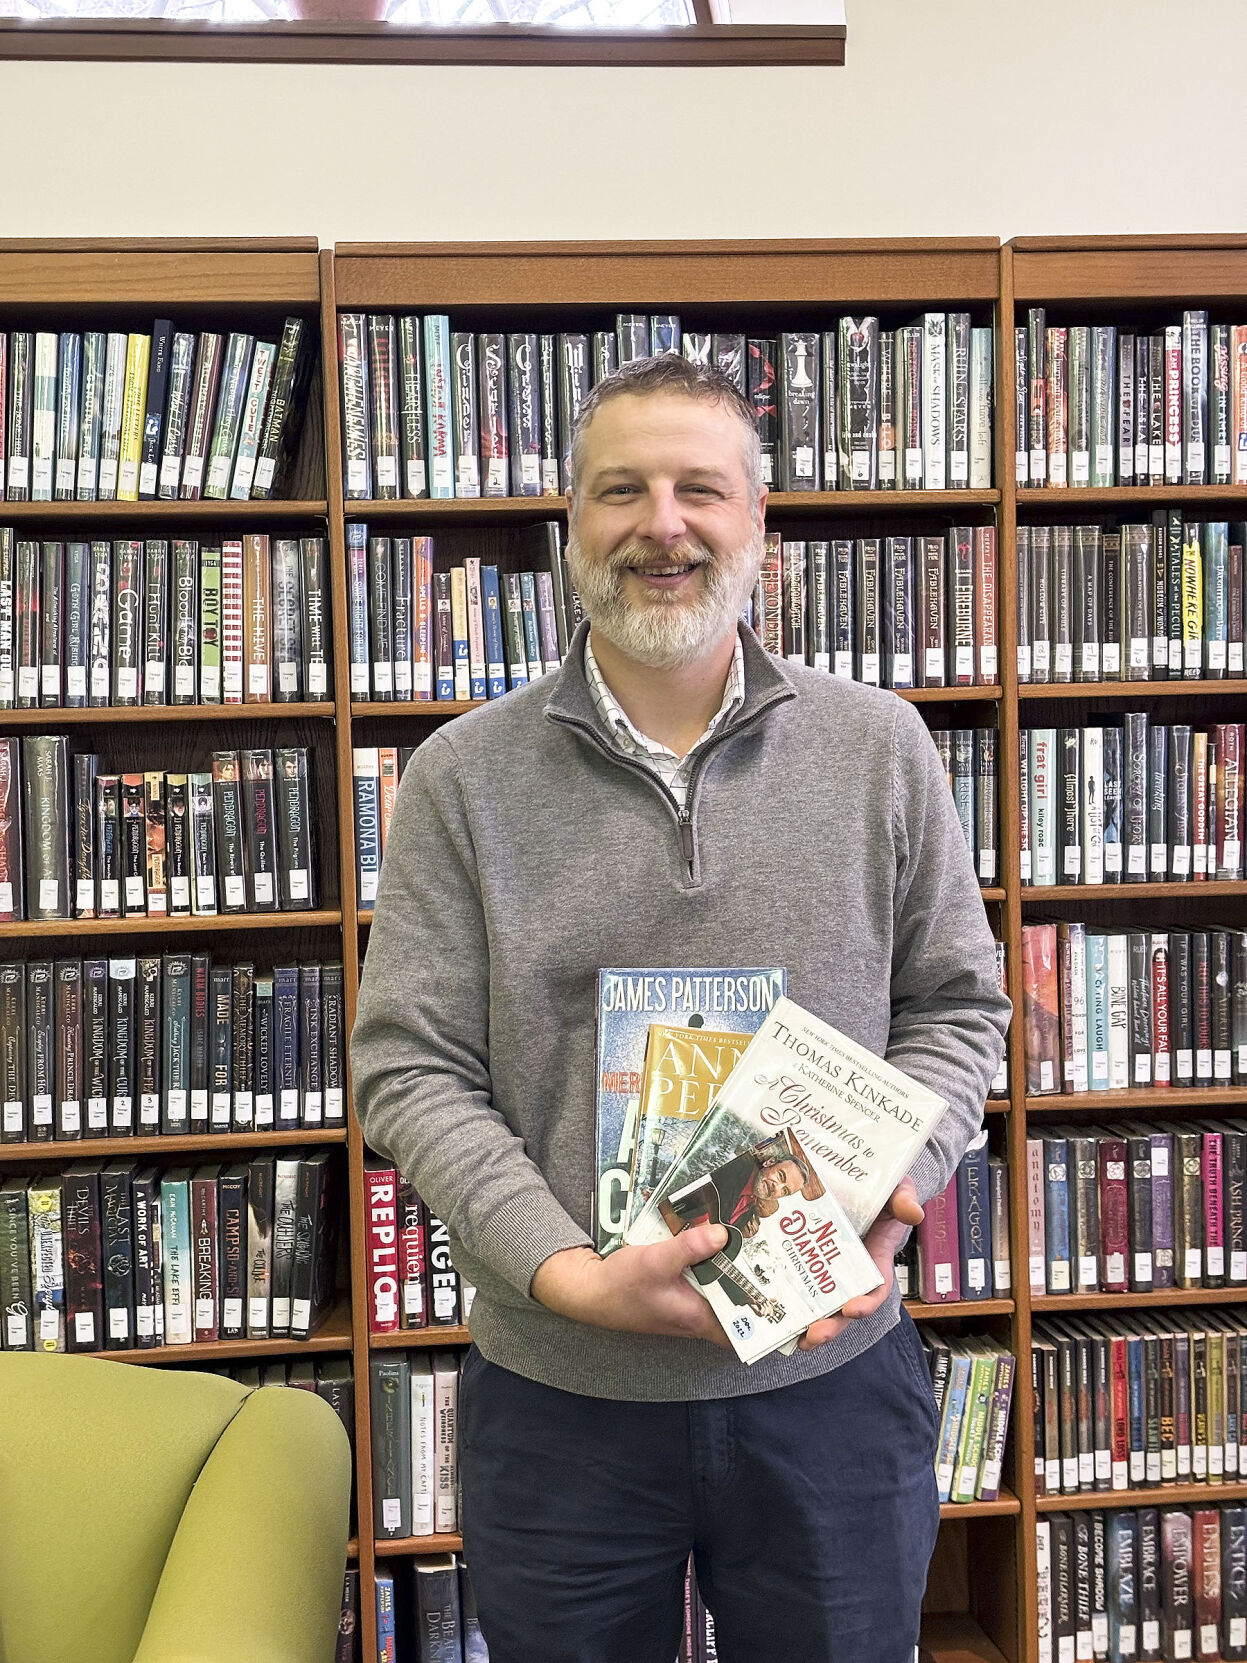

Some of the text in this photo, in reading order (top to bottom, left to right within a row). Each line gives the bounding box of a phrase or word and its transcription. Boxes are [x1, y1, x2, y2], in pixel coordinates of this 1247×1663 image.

[882, 350, 890, 395] WHERE
[1192, 332, 1200, 395] THE BOOK
[248, 350, 266, 432] TWEET CUTE
[401, 374, 423, 443] HEARTLESS
[931, 345, 940, 445] MASK SHADOWS
[952, 347, 967, 441] RUIN STARS
[1122, 375, 1131, 443] THE FEAR
[1153, 375, 1161, 445] THE LAKE
[1169, 370, 1180, 443] PRINCESS
[270, 399, 285, 442] BATMAN
[432, 414, 447, 456] KARMA
[376, 563, 387, 627] COME FIND
[983, 561, 993, 577] THE
[1171, 552, 1180, 585] TALES
[1184, 558, 1198, 617] NOWHERE
[1, 581, 11, 644] LAST MAN
[71, 611, 80, 632] GIRL
[118, 589, 138, 658] Game
[179, 577, 193, 619] Blood
[203, 588, 218, 615] BOY
[278, 581, 295, 633] SECRET
[308, 589, 321, 622] TIME
[816, 571, 826, 630] FABLEHAVEN
[839, 570, 847, 629] FABLEHAVEN
[866, 569, 876, 628] FABLEHAVEN
[894, 567, 905, 629] FABLEHAVEN
[928, 567, 939, 629] FABLEHAVEN
[955, 585, 973, 646] FIREBORNE
[253, 597, 265, 660] THE HIVE
[395, 596, 407, 658] Fracture
[960, 782, 970, 808] RISE
[1034, 742, 1047, 799] frat girl
[1152, 772, 1165, 812] breaking
[41, 797, 51, 850] KINGDOM
[222, 791, 236, 837] PENDRAGON
[254, 789, 267, 834] PENDRAGON
[288, 787, 300, 832] PENDRAGON
[358, 780, 376, 849] RAMONA
[384, 785, 395, 812] Dear
[1036, 808, 1045, 827] kiley
[1064, 773, 1077, 832] Almost There
[196, 968, 205, 1017] WARM BODIES
[602, 976, 775, 1012] JAMES PATTERSON
[1111, 987, 1126, 1029] BONE GAP
[1157, 965, 1167, 1033] IT'S ALL YOUR
[89, 1018, 104, 1061] KINGDOM
[114, 1018, 128, 1061] KINGDOM
[141, 1020, 155, 1060] KINGDOM
[215, 994, 229, 1086] MADE FOR
[238, 1015, 247, 1052] MEMORY
[328, 1000, 337, 1044] RADIANT
[695, 1035, 717, 1043] TIMES
[37, 1054, 46, 1077] FROM
[602, 1072, 641, 1093] MER
[771, 1021, 924, 1132] THOMAS KINKADE
[802, 1026, 910, 1099] NEW YORK TIMES BESTSELLING AUTHORS
[779, 1076, 865, 1150] Christmas
[863, 1147, 875, 1158] to
[798, 1062, 881, 1123] KATHERINE SPENCER
[76, 1187, 89, 1235] DEVIL'S
[967, 1167, 984, 1254] ERAGON
[1209, 1158, 1218, 1228] TRUTH BENEATH
[1230, 1180, 1243, 1207] ASH
[8, 1208, 17, 1234] SINCE
[116, 1206, 130, 1245] LAST
[138, 1200, 148, 1268] WORK OF ART
[226, 1209, 239, 1244] CAMP
[808, 1221, 841, 1265] NEIL
[170, 1245, 179, 1285] THE LAKE
[198, 1238, 212, 1299] BREAKING
[370, 1184, 397, 1317] REPLIC
[780, 1210, 836, 1294] DIAMOND
[782, 1239, 818, 1298] CHRISTMAS
[935, 1355, 948, 1378] JAMES
[1002, 1364, 1011, 1389] JAMES
[974, 1411, 985, 1442] MIDDLE
[996, 1410, 1006, 1441] MIDDLE
[1117, 1440, 1125, 1459] LOSS
[1161, 1416, 1174, 1442] BEC
[439, 1465, 449, 1490] KISS
[1077, 1545, 1089, 1622] BONE THIEF
[1094, 1522, 1104, 1610] BECOME SHADOW
[1118, 1530, 1134, 1604] EMBLAZE
[1142, 1526, 1155, 1592] EMBRACE
[1172, 1529, 1188, 1606] EMPOWER
[1203, 1524, 1219, 1599] ENDLESS
[1230, 1526, 1246, 1590] ENTICE
[444, 1604, 452, 1618] THE
